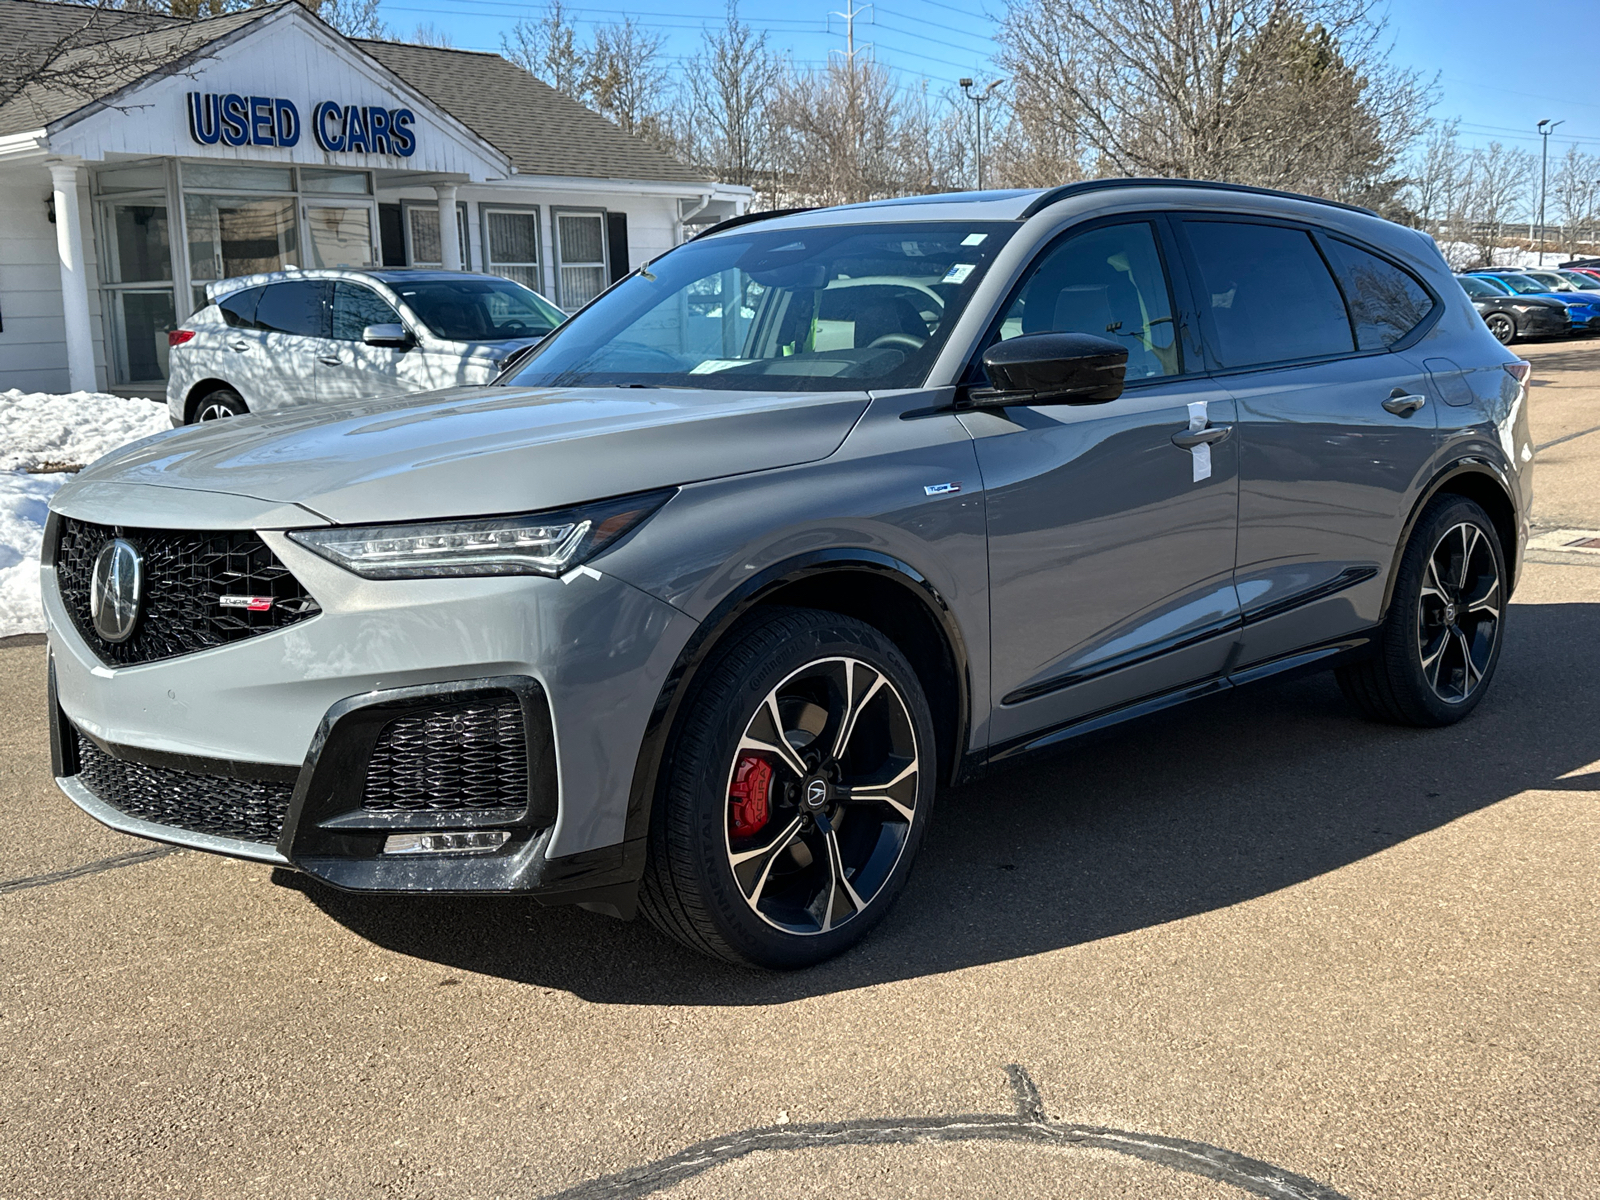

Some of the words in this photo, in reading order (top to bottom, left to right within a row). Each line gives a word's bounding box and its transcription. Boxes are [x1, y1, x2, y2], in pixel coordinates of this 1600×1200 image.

[187, 92, 300, 147] USED
[313, 100, 417, 157] CARS
[755, 767, 767, 823] ACURA
[701, 809, 765, 951] ONTINENTAL
